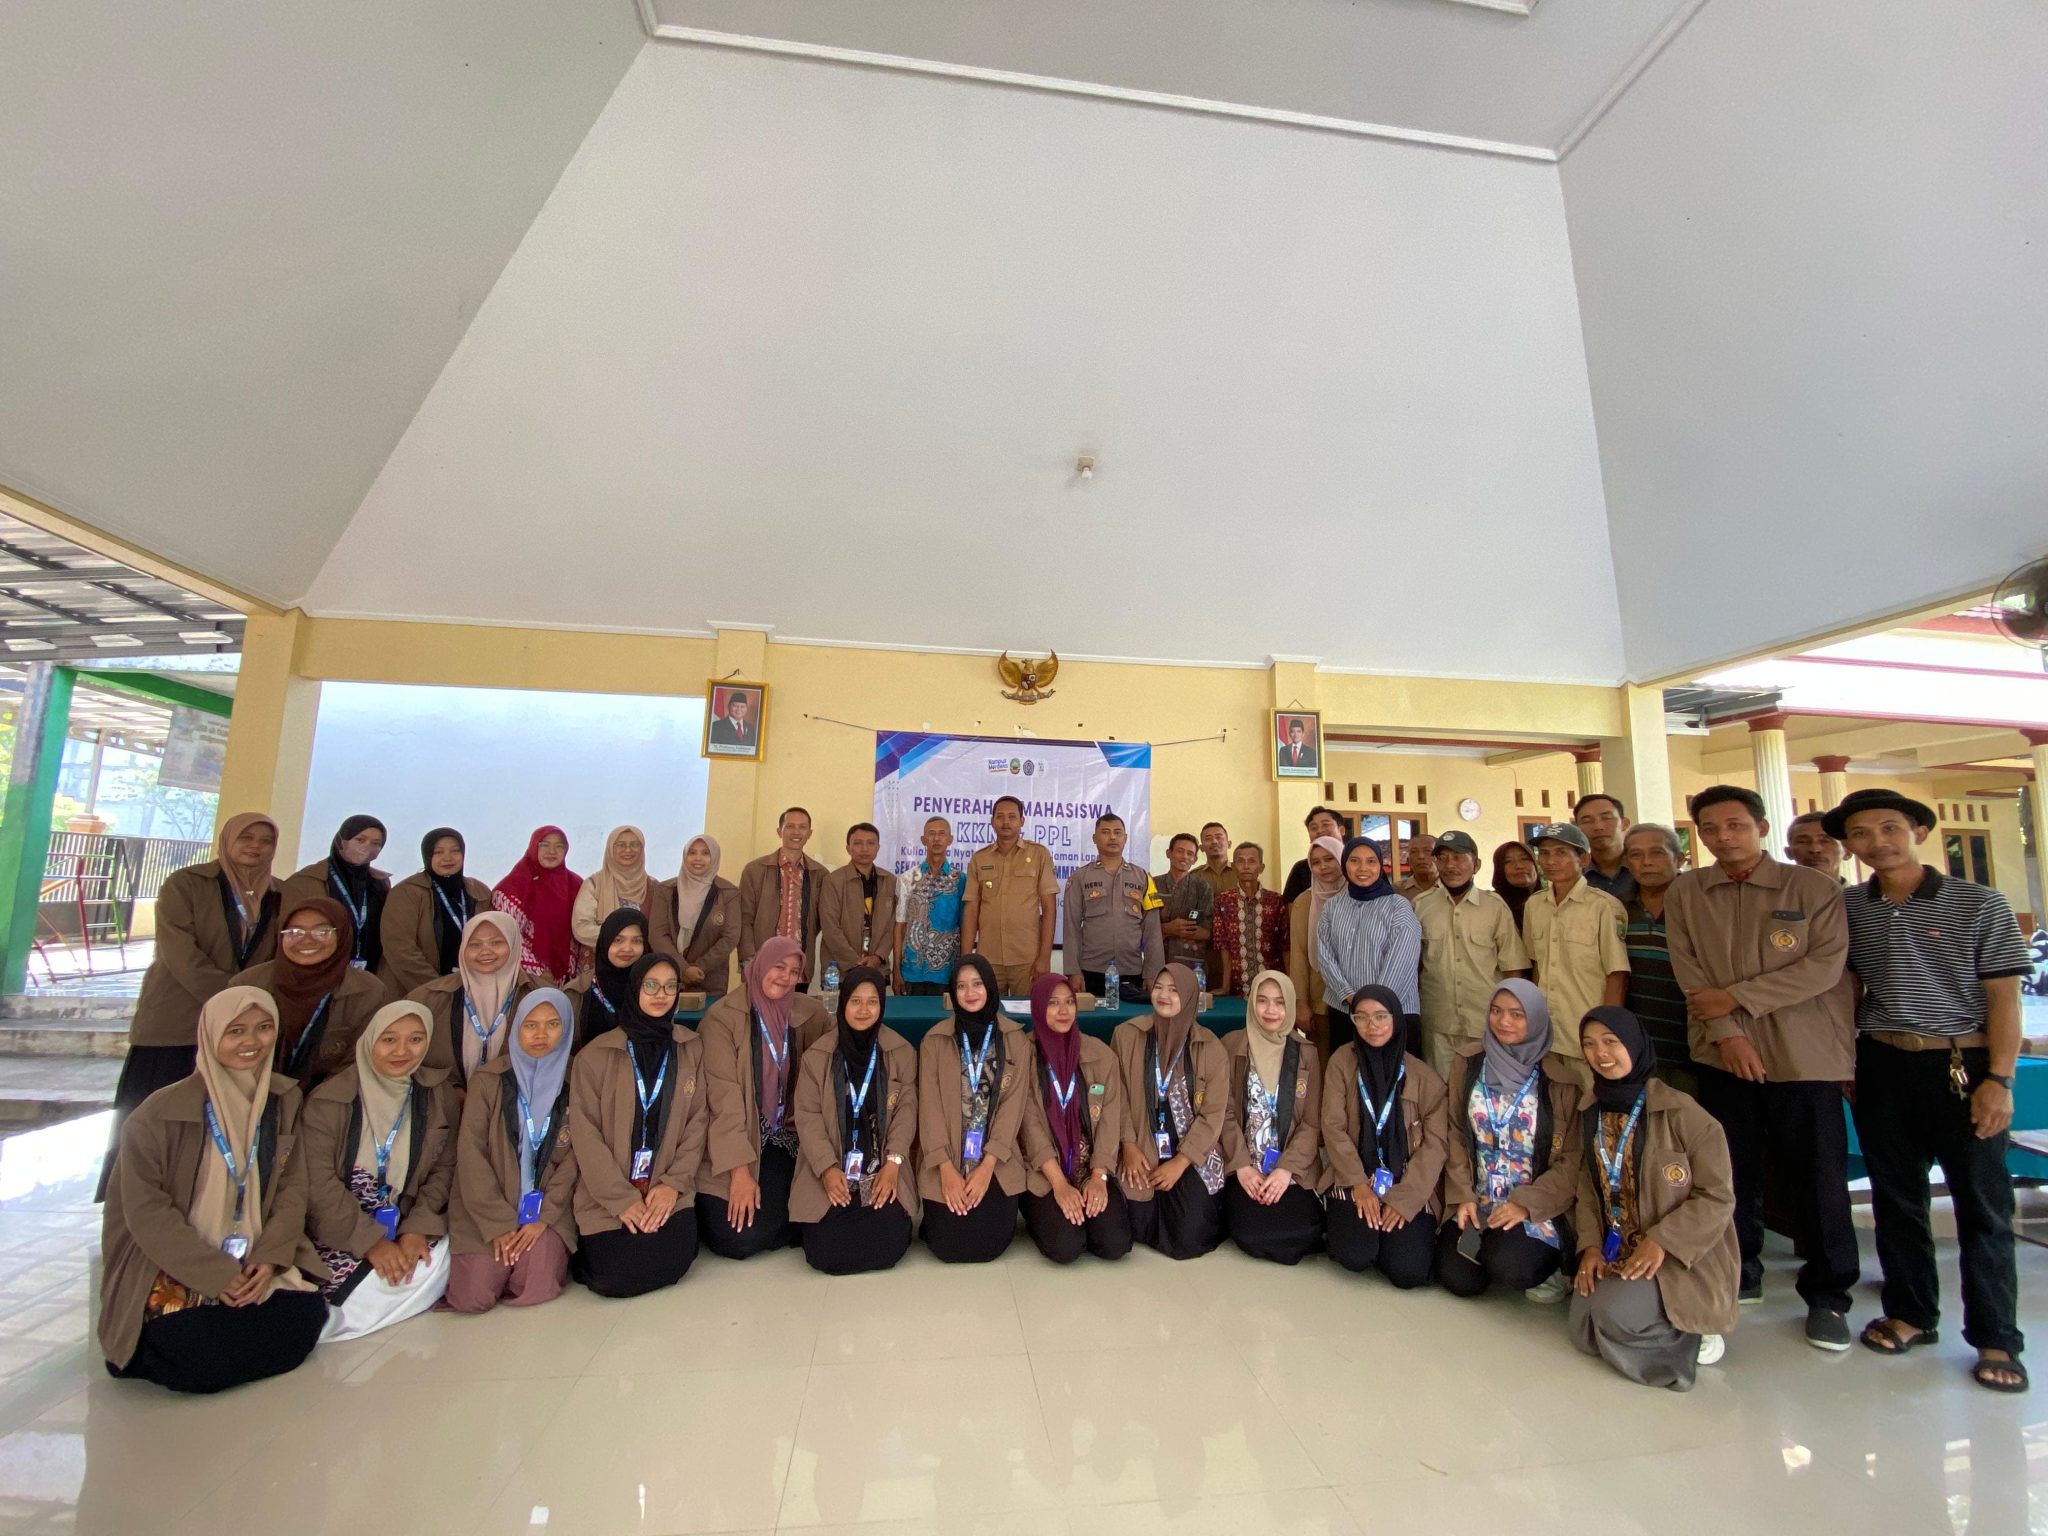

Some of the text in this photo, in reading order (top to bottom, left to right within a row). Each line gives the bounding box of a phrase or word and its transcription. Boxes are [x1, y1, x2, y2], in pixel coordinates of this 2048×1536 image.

[914, 796, 1113, 819] PENYERAH MAHASISWA
[1034, 825, 1071, 846] PPL
[954, 848, 974, 860] Nyat
